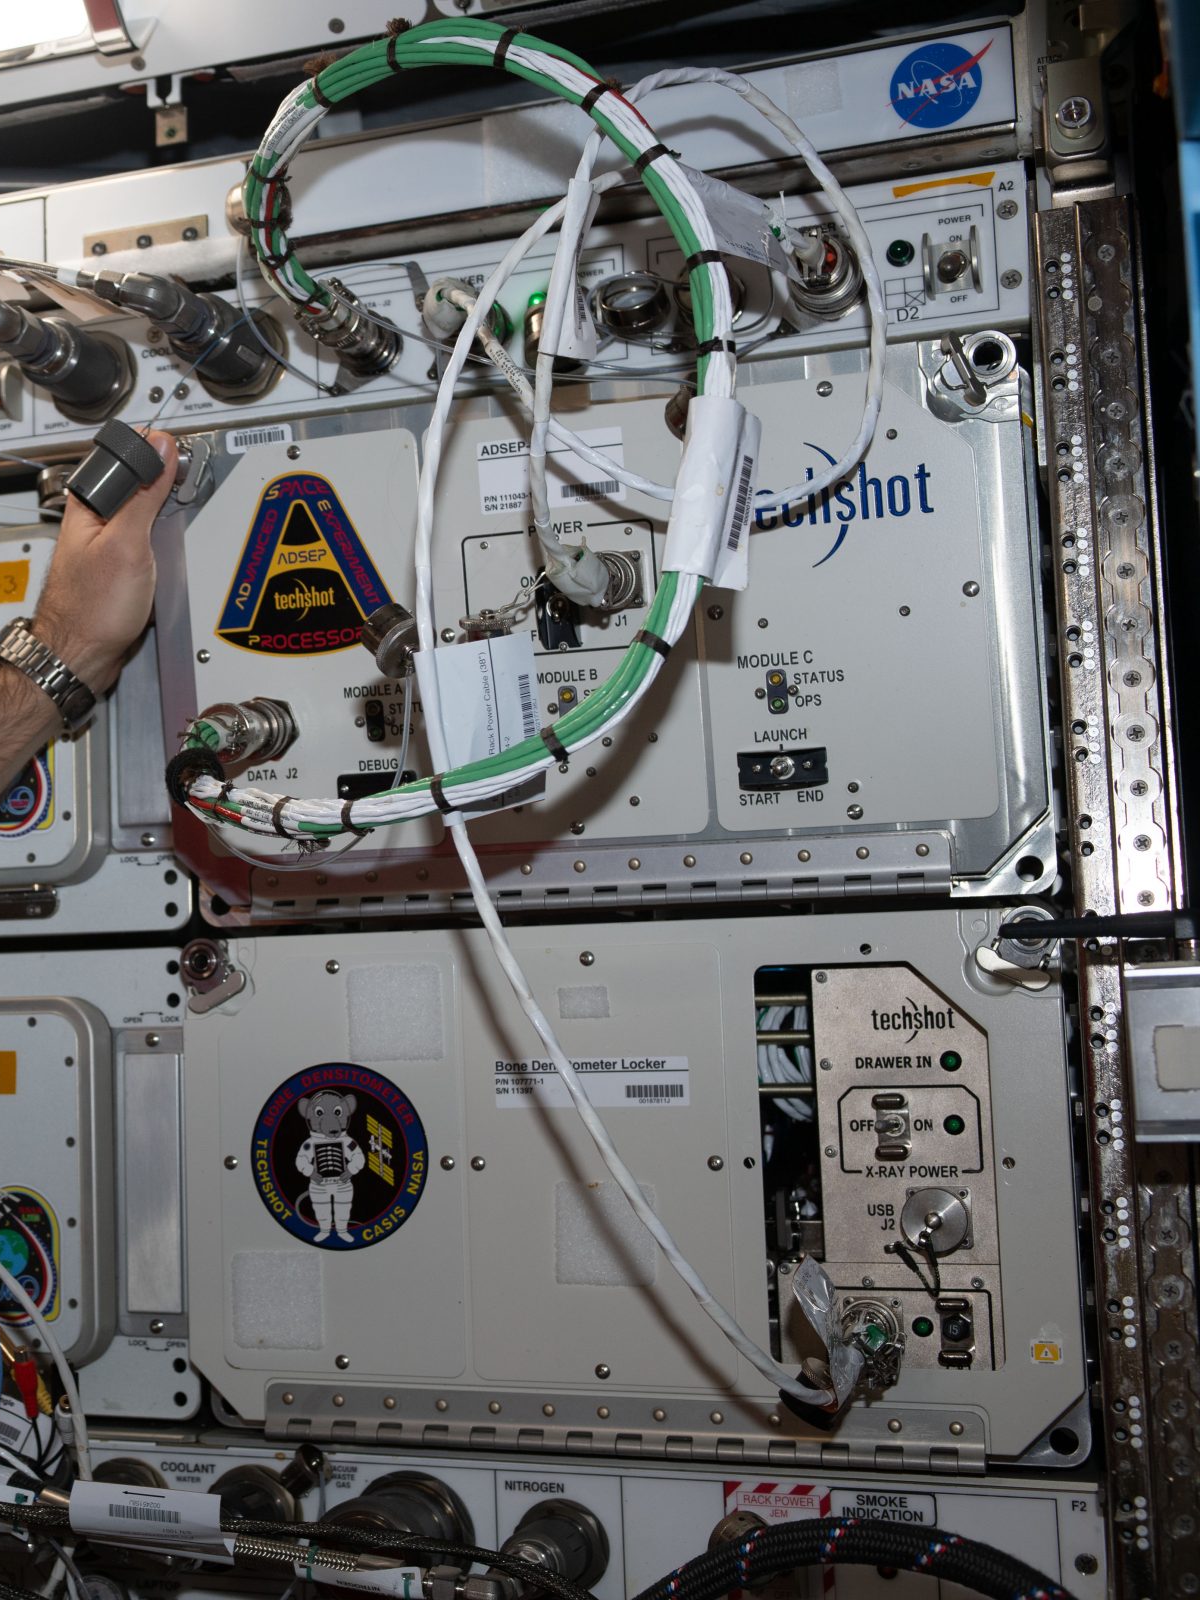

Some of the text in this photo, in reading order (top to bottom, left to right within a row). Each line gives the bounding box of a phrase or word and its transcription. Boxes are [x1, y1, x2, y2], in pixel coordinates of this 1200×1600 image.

[897, 71, 977, 100] NASA
[998, 180, 1014, 192] A2
[938, 214, 971, 226] POWER
[949, 234, 962, 243] ON
[578, 269, 604, 278] OWER
[950, 294, 968, 304] OFF
[896, 307, 920, 322] D2
[141, 349, 173, 359] COOL
[183, 402, 213, 411] RETURN
[44, 421, 70, 430] SUPPLY
[481, 441, 531, 457] ADSEP-
[264, 480, 331, 501] SPACE
[755, 462, 935, 531] echshot
[484, 495, 497, 503] P/N
[484, 502, 522, 512] S/N 21887
[528, 521, 583, 537] PWER
[277, 549, 327, 565] ADSEP
[316, 499, 382, 605] EXPERIMENT
[235, 508, 279, 611] ADVANCED
[520, 576, 538, 588] ON
[274, 586, 336, 611] techshot
[615, 614, 628, 627] J1
[737, 650, 814, 669] MODULE C
[536, 668, 598, 685] MODULE B
[793, 669, 845, 685] STATUS
[344, 684, 403, 699] MODULE A
[481, 675, 491, 702] Cable
[795, 693, 822, 708] OPS
[389, 701, 424, 715] STTU
[486, 703, 494, 731] Power
[754, 728, 808, 743] LAUNCH
[359, 758, 399, 772] DEBUG
[248, 768, 298, 782] DATA J2
[739, 789, 824, 806] START END
[871, 1004, 956, 1030] techshot
[495, 1058, 666, 1072] Bone Denometer Locker
[855, 1055, 932, 1069] DRAWER IN
[495, 1077, 544, 1086] P/N 107771-1
[263, 1069, 414, 1127] BONE DENSITOMETER
[495, 1087, 533, 1095] S/N 11397
[850, 1119, 933, 1132] OFF ON
[866, 1165, 959, 1178] X-RAY POWER
[256, 1139, 293, 1220] TECHSHOT
[362, 1150, 424, 1241] CASIS NASA
[867, 1204, 894, 1216] USB
[880, 1218, 895, 1231] J2
[160, 1461, 216, 1474] COOLANT
[505, 1480, 564, 1493] NITROGEN
[743, 1494, 814, 1507] RACK POWER
[856, 1494, 908, 1509] SMOKE
[1071, 1500, 1088, 1512] F2
[769, 1508, 789, 1518] JEM
[842, 1506, 924, 1522] INDICATION
